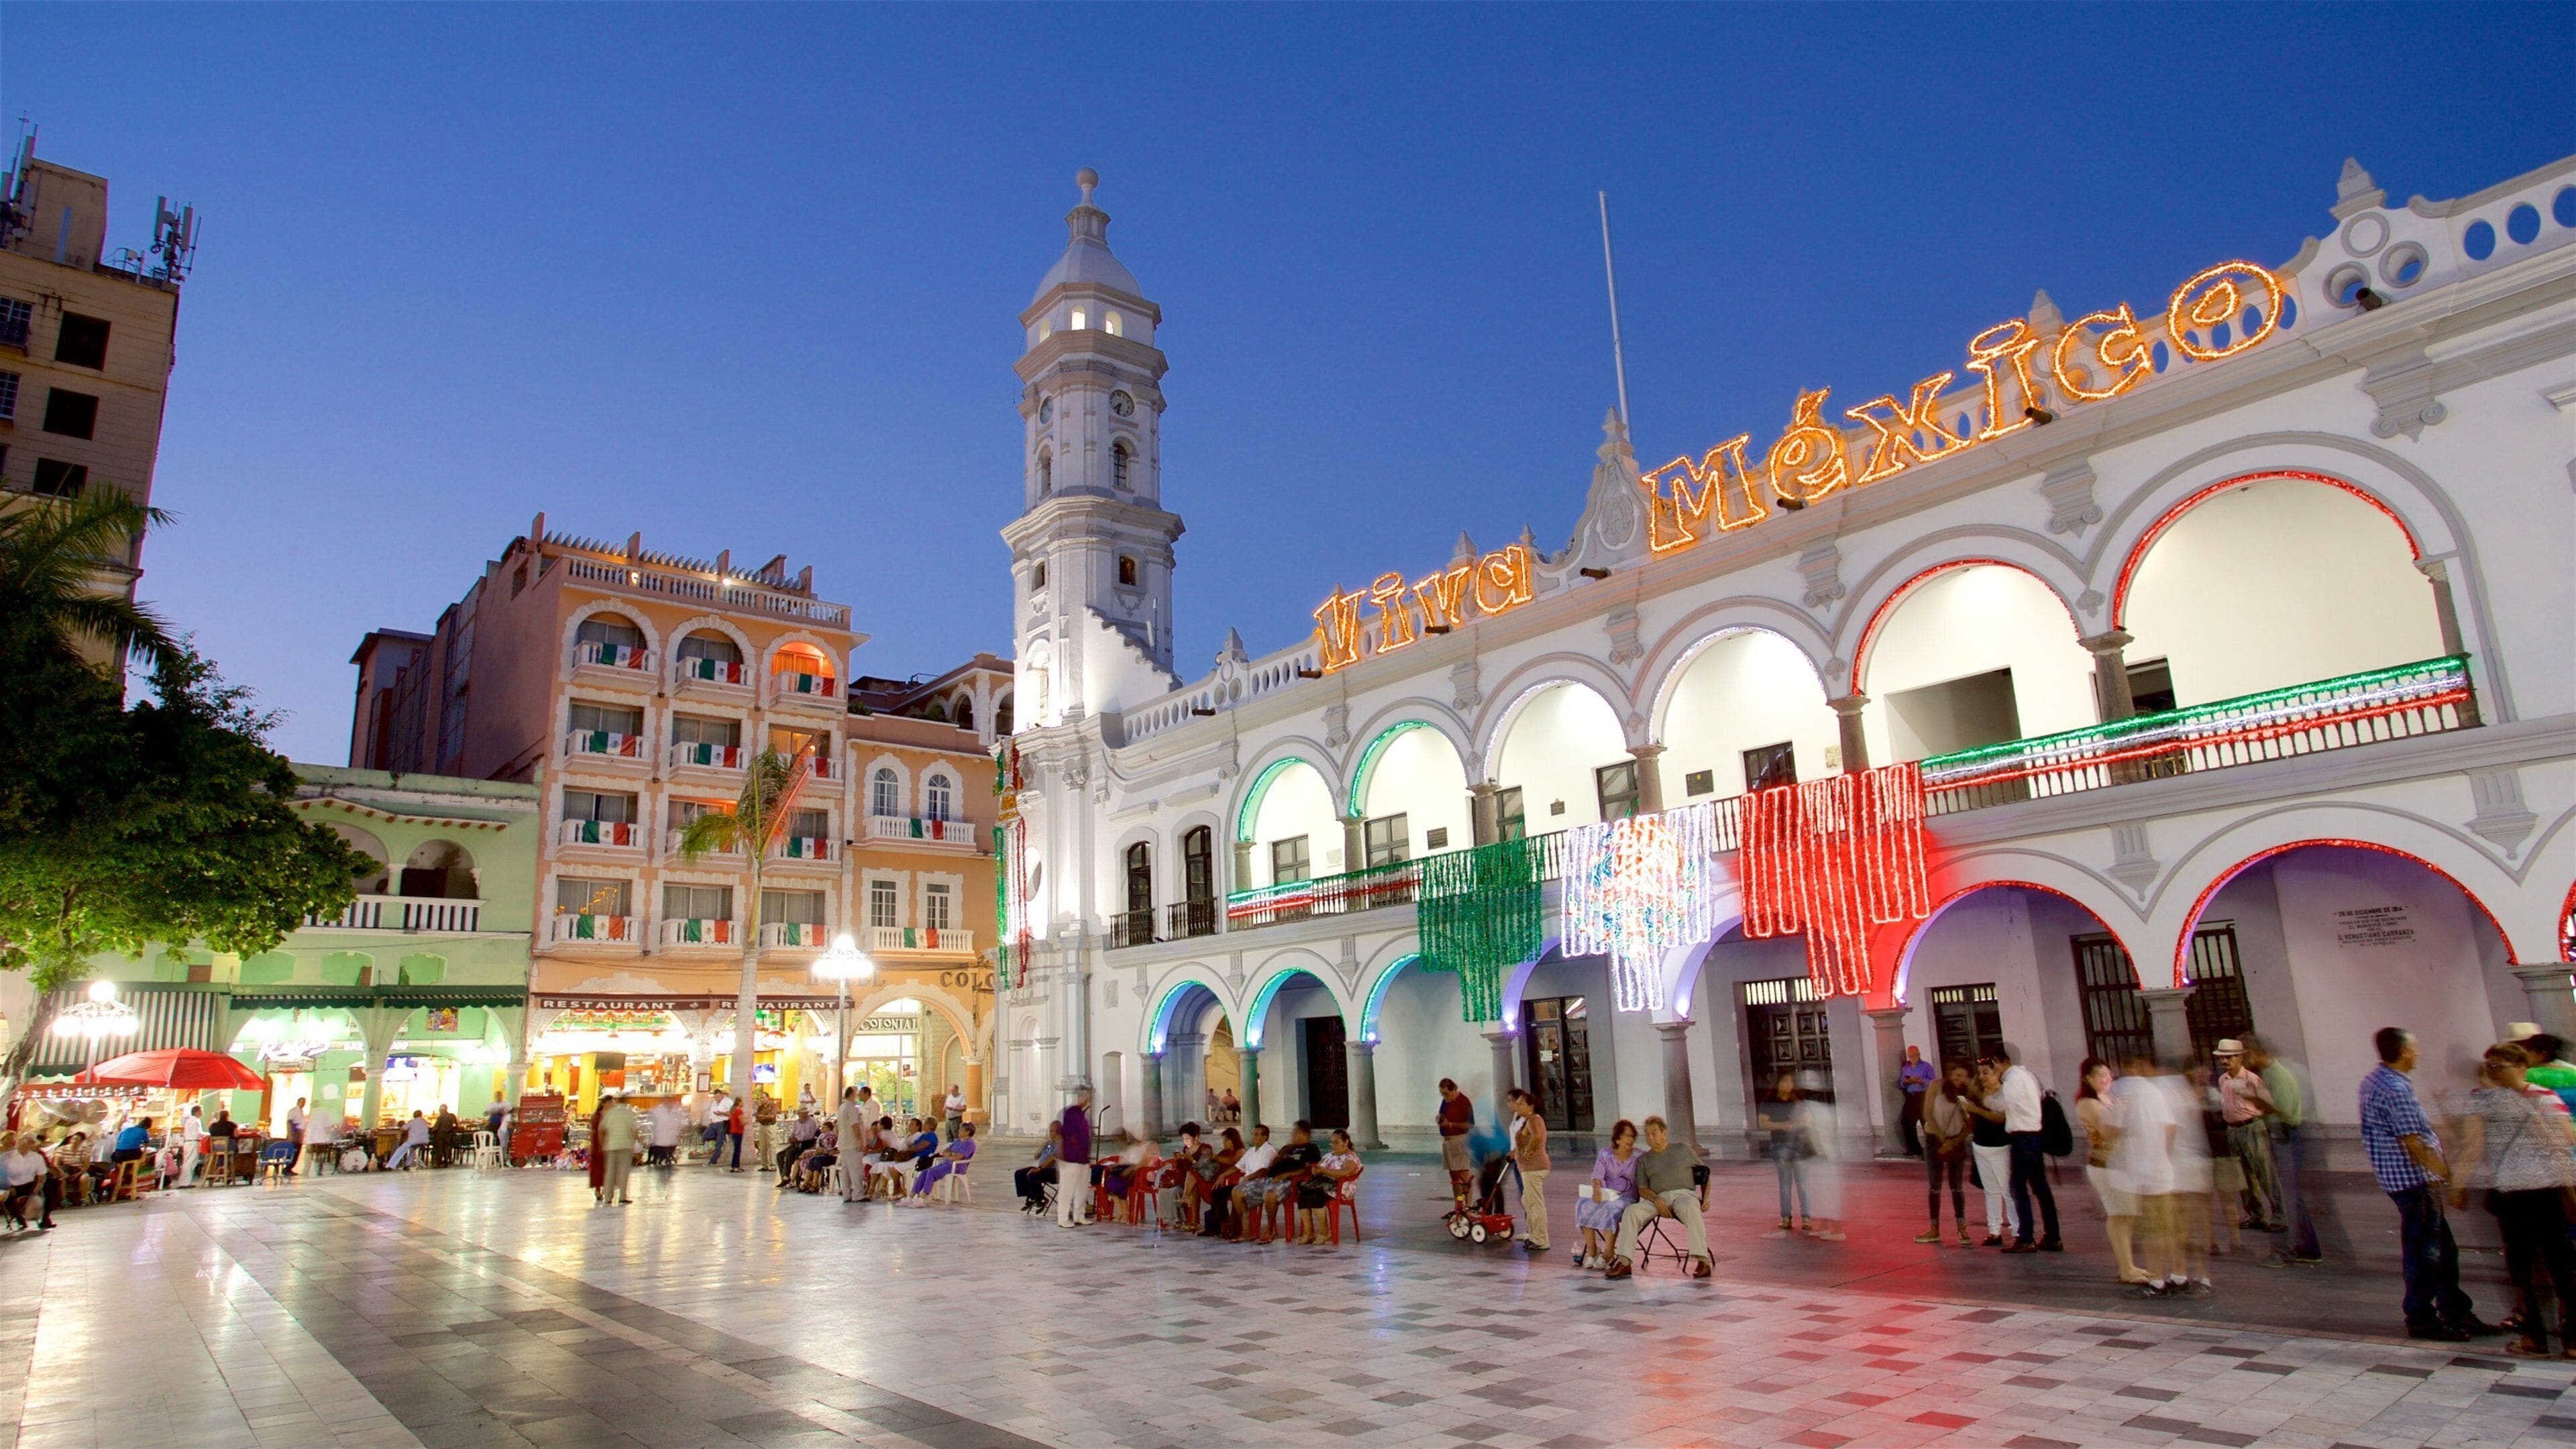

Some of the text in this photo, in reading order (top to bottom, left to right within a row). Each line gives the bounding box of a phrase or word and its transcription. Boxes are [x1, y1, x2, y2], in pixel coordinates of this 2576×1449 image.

[1313, 258, 2284, 673] Viva México
[2345, 931, 2381, 940] VENUSTIANO
[2382, 928, 2414, 937] CARRANZA
[543, 1000, 676, 1010] RESTAURANT
[721, 1001, 836, 1009] RTAURANT
[860, 1017, 918, 1031] COLONIAL
